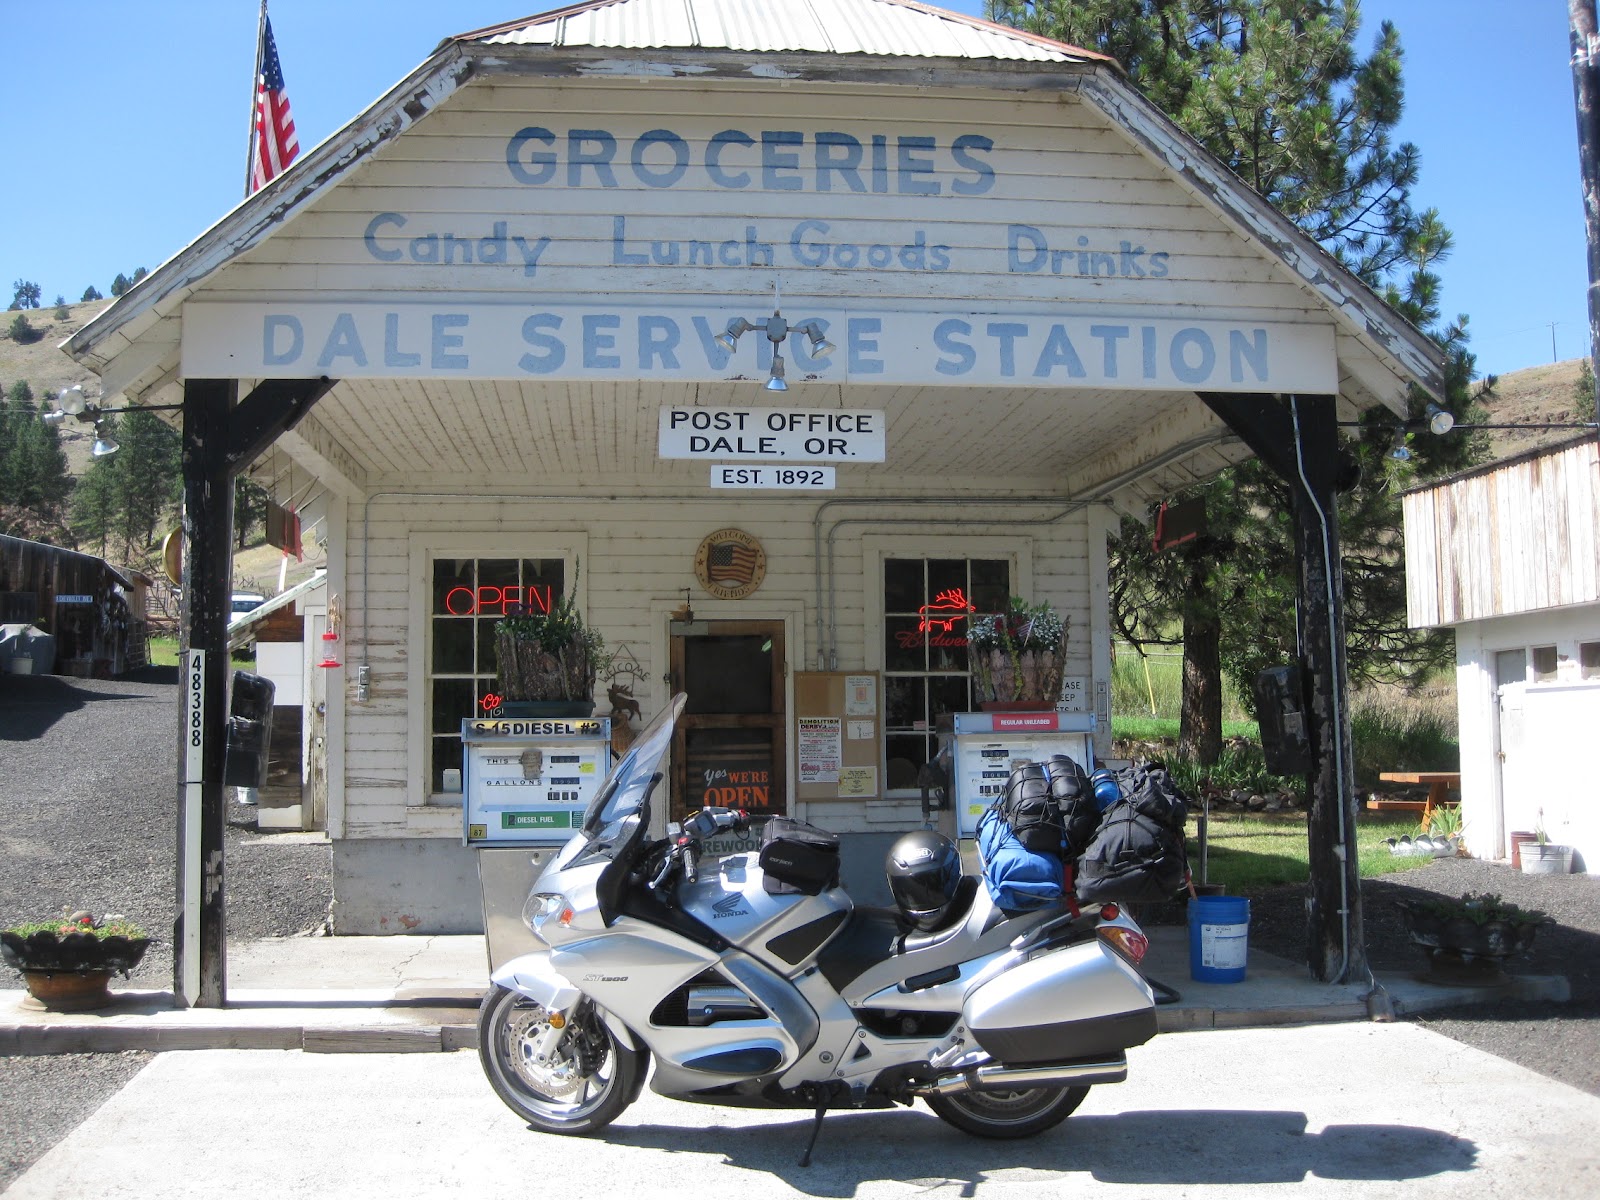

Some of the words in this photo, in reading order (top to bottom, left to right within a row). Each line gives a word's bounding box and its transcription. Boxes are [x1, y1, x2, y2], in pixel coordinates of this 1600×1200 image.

[505, 126, 996, 195] GROCERIES
[364, 212, 552, 277] Candy
[613, 215, 775, 267] Lunch
[789, 219, 951, 272] Goods
[1007, 224, 1170, 278] Drinks
[262, 312, 470, 369] DALE
[517, 312, 884, 374] SERVICE
[933, 318, 1268, 384] STATION
[670, 411, 750, 431] POST
[767, 413, 873, 433] OFFICE
[690, 436, 786, 456] DALE,
[804, 438, 856, 455] OR.
[722, 469, 764, 485] EST.
[775, 470, 824, 485] 1892
[446, 585, 551, 615] OPEN
[597, 661, 650, 683] WELCOME
[191, 654, 202, 747] 48388
[513, 722, 575, 735] DIESEL
[581, 722, 601, 735] #2
[729, 771, 768, 784] WE'RE
[704, 786, 769, 807] OPEN
[712, 909, 749, 919] HONDA
